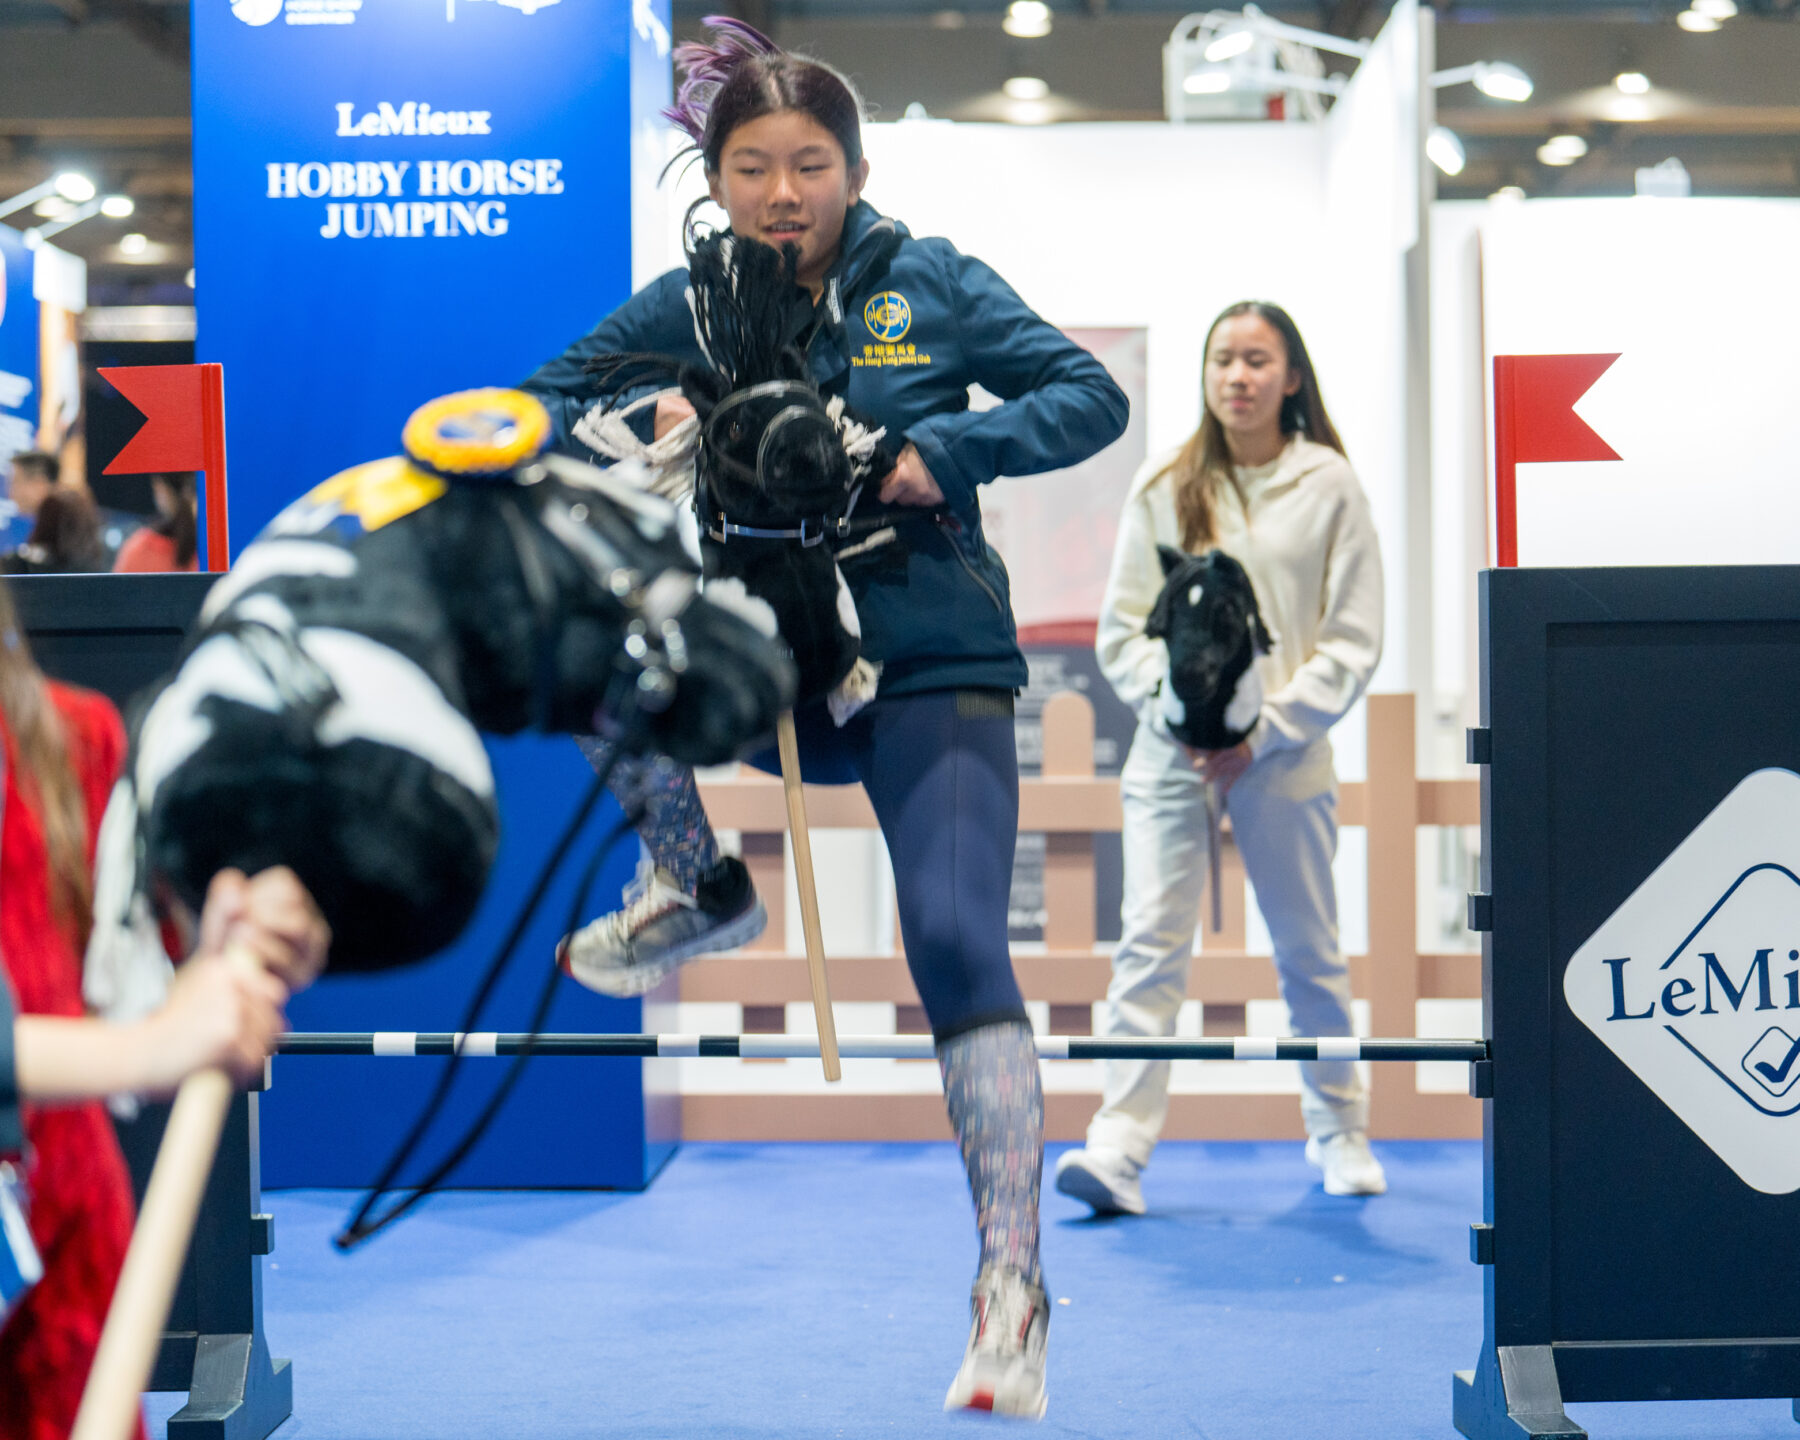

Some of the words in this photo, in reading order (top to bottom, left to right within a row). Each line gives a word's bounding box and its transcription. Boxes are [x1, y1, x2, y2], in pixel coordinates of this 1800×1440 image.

[335, 101, 492, 137] LeMieux
[265, 161, 410, 198] HOBBY
[417, 158, 565, 196] HORSE
[319, 201, 509, 239] JUMPING
[851, 356, 864, 367] The
